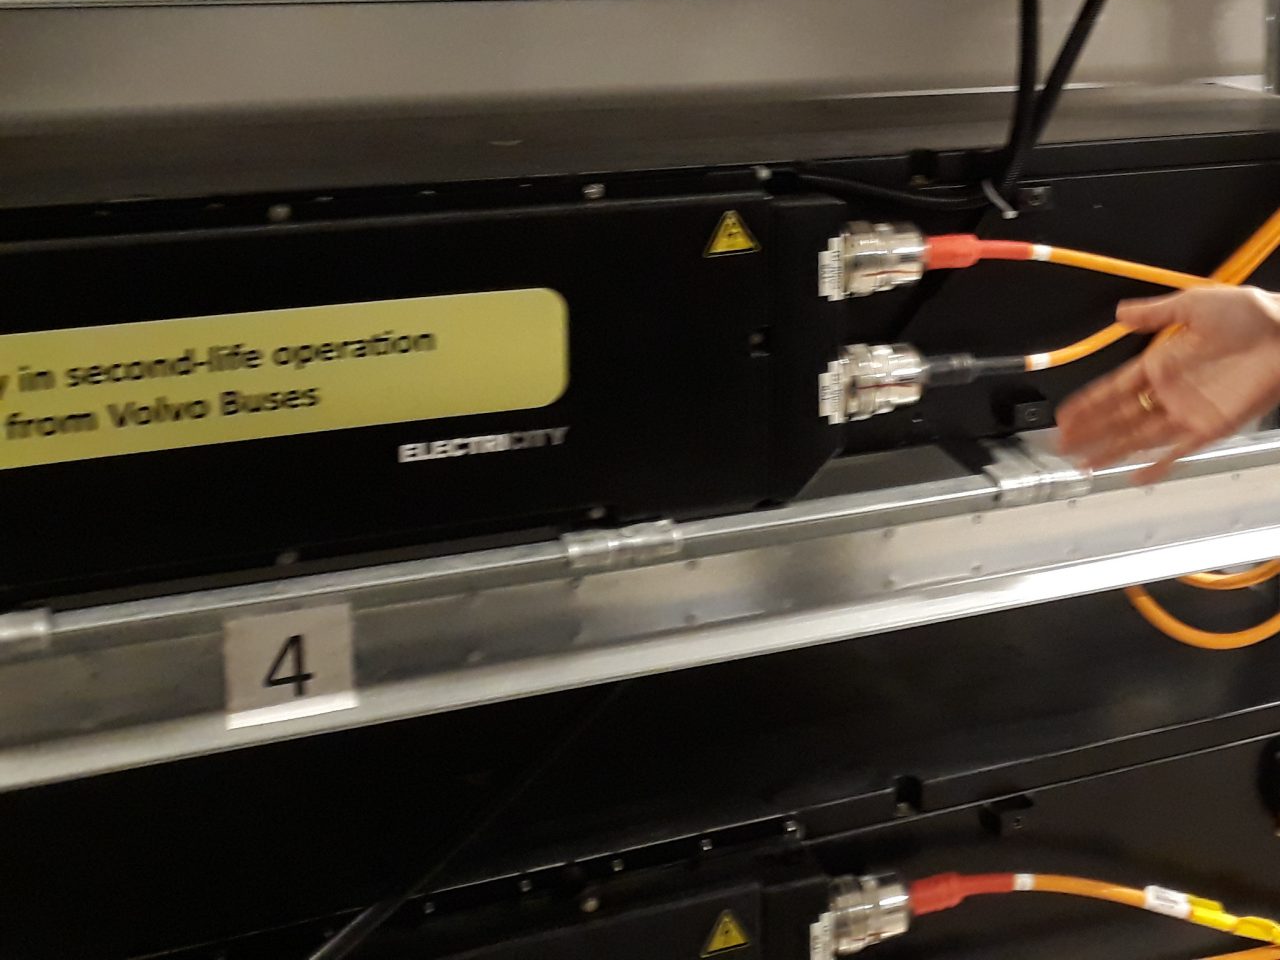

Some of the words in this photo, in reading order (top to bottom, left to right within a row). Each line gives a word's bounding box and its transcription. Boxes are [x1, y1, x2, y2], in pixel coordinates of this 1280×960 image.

[18, 365, 55, 392] in
[65, 342, 263, 387] second-life
[271, 330, 438, 370] operation
[6, 411, 97, 440] from
[107, 396, 209, 428] Volvo
[220, 386, 321, 416] Buses
[263, 633, 315, 698] 4
